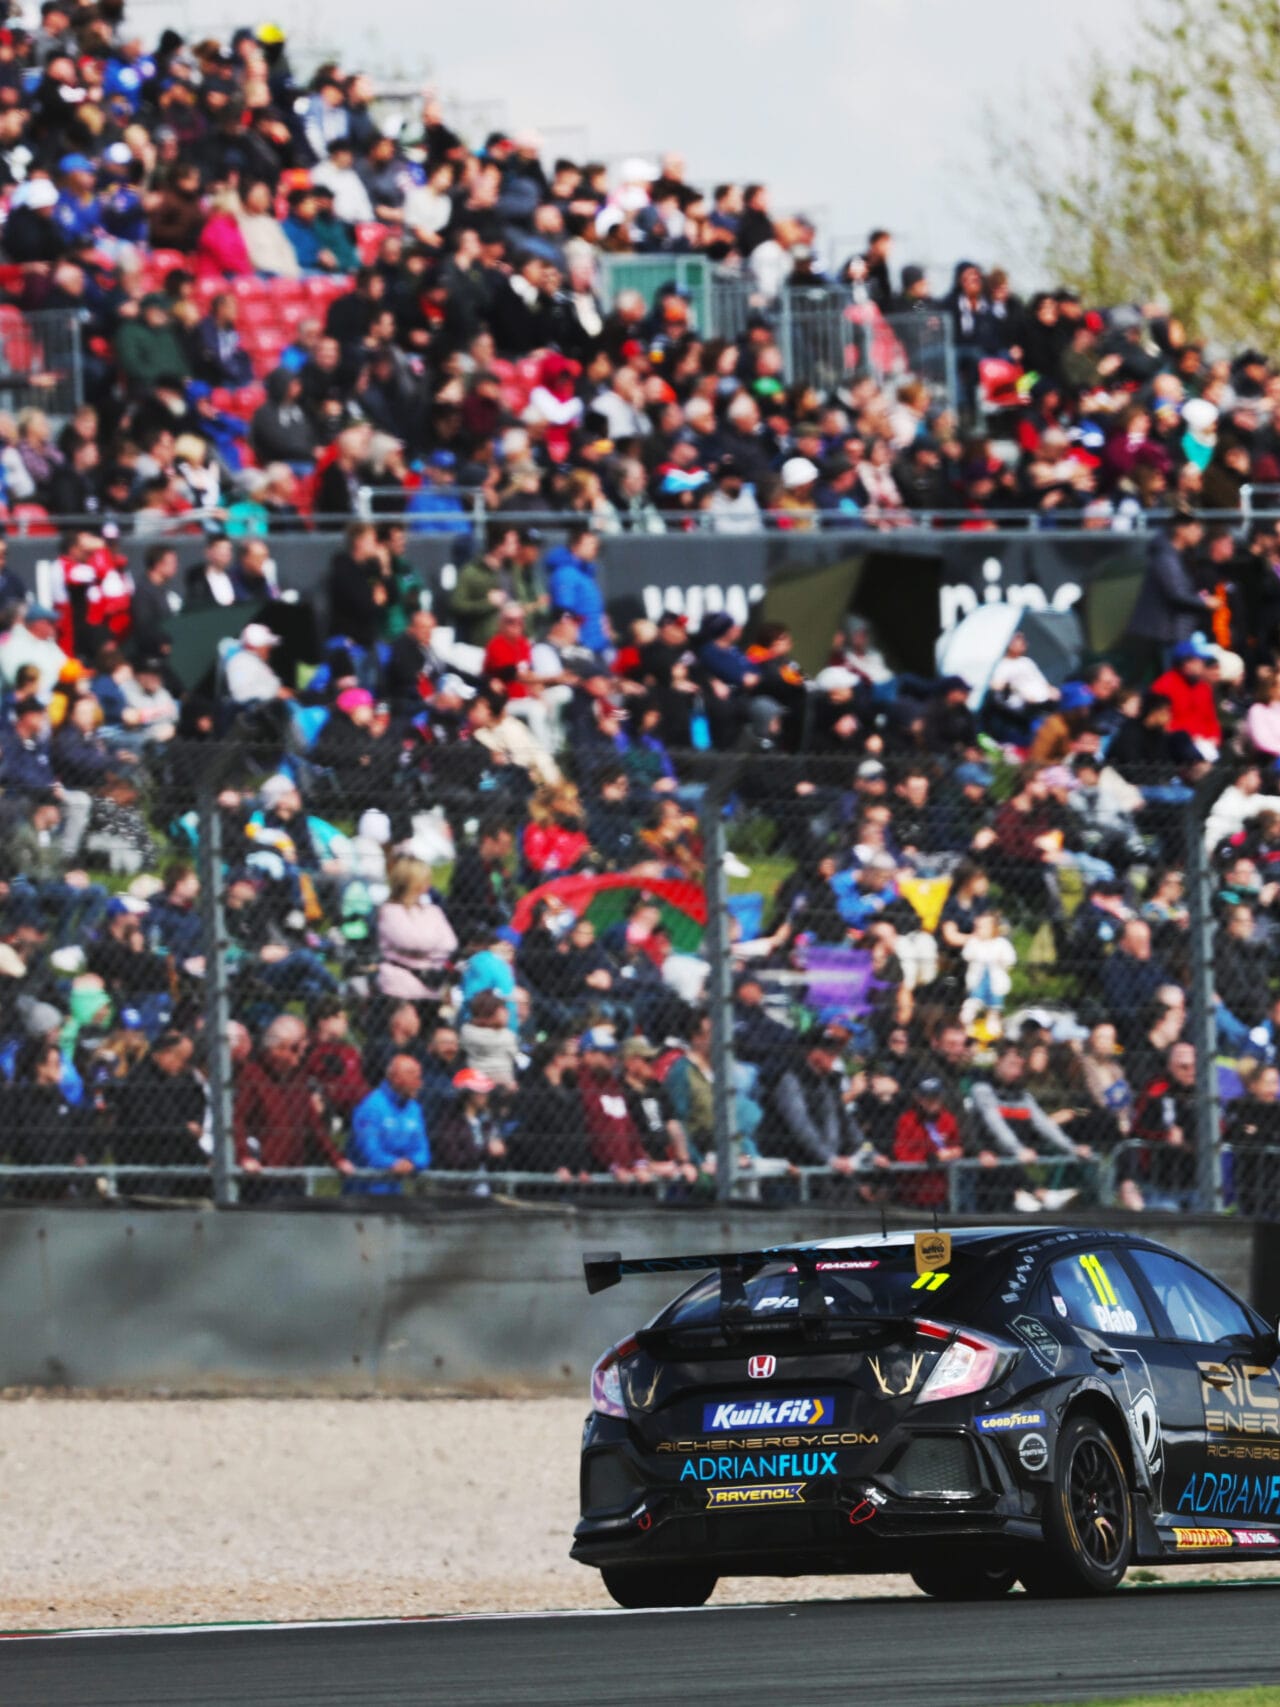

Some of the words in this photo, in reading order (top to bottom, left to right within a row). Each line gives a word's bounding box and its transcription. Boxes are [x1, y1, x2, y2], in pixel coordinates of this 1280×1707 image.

[911, 1271, 950, 1291] 11
[1079, 1254, 1117, 1305] 11
[1092, 1305, 1137, 1332] Plato
[982, 1413, 1040, 1428] GOODYEAR
[656, 1433, 879, 1452] RICHENERGY.COM
[716, 1488, 795, 1503] RAVENOL
[1180, 1529, 1230, 1545] AUTOCAR
